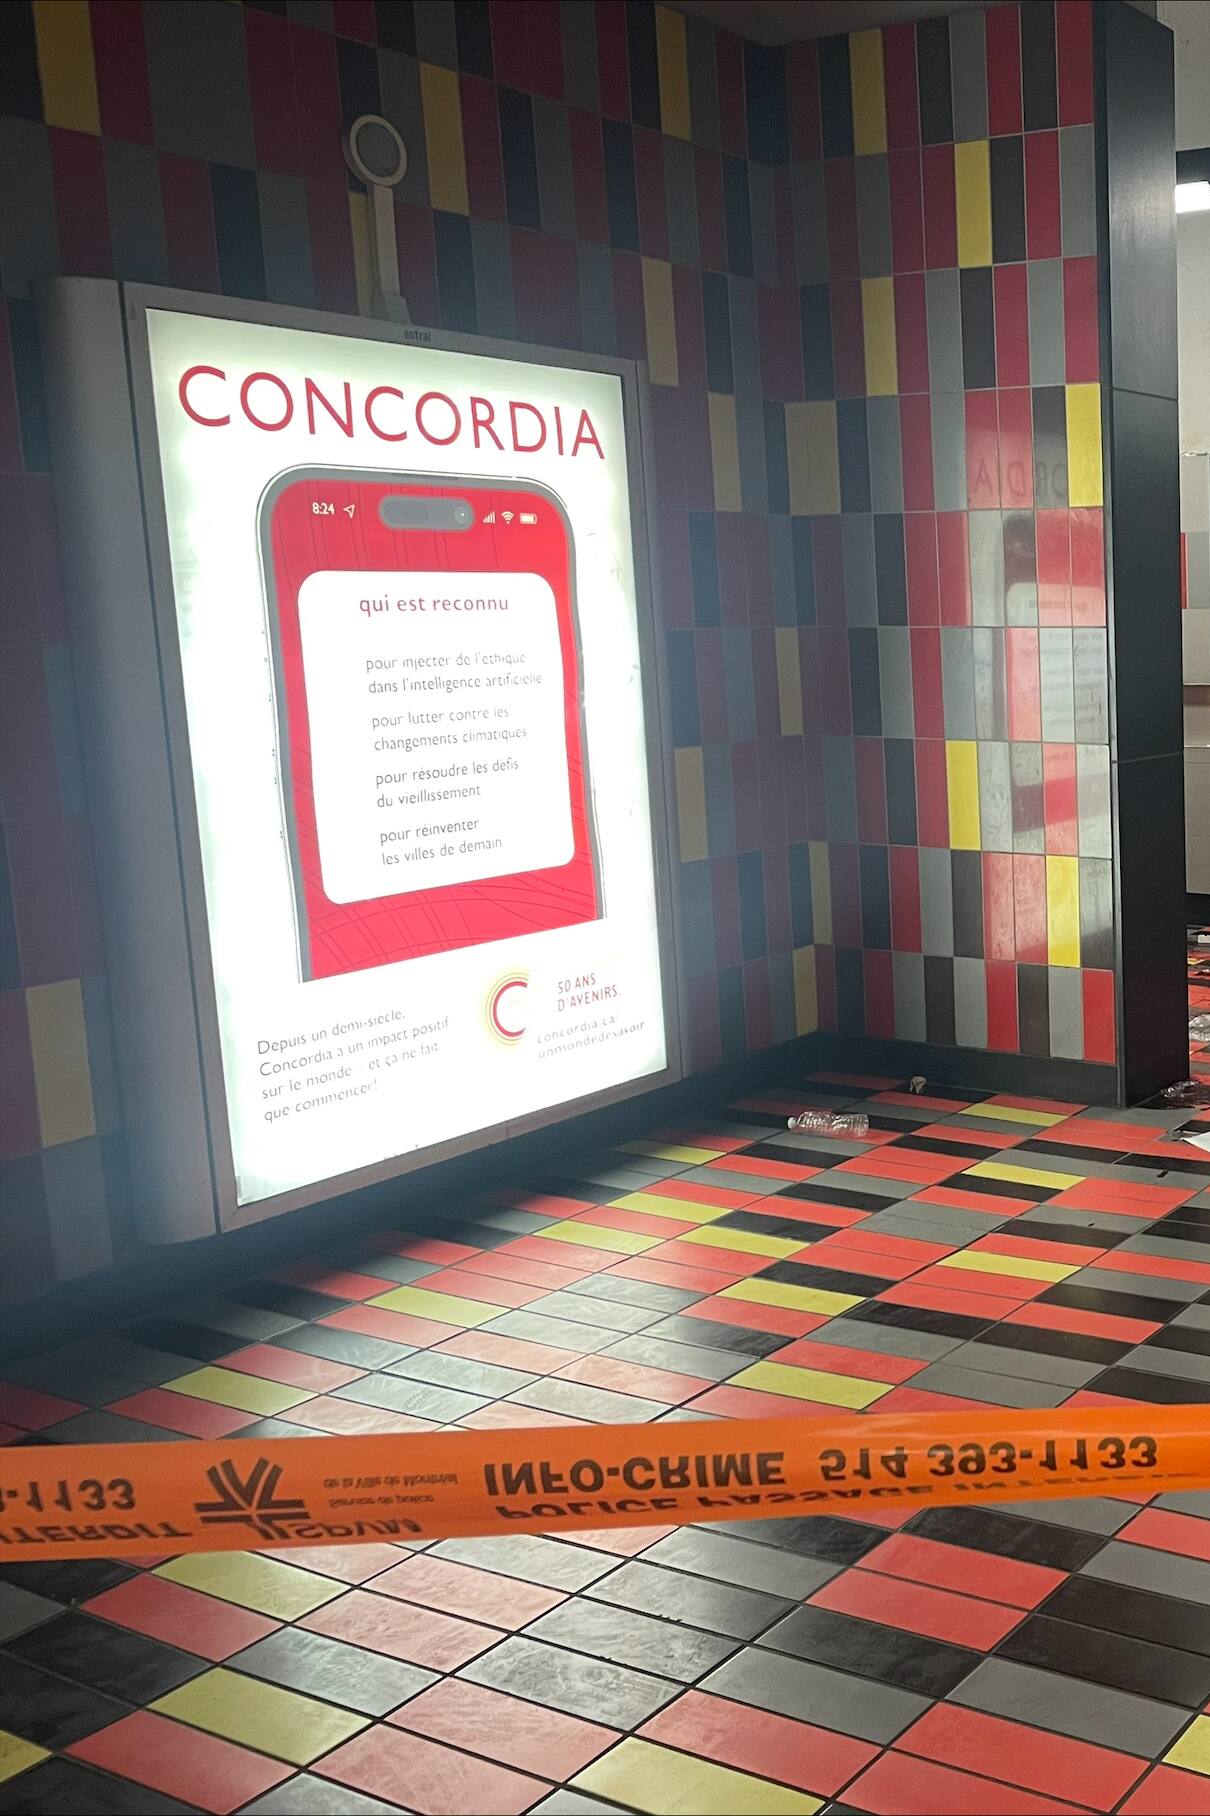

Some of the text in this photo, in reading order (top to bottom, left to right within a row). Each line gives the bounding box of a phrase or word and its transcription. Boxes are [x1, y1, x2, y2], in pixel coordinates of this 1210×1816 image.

[178, 365, 605, 460] CONCORDIA
[312, 501, 335, 516] 8:24
[359, 594, 509, 617] qui est reconnu
[366, 658, 397, 674] pour
[402, 656, 450, 671] injecter
[456, 653, 471, 666] de
[368, 672, 543, 694] dans l'intelligence artificielle
[371, 706, 510, 731] pour lutter contre les
[374, 728, 528, 752] changements climatiques
[375, 772, 407, 789] pour
[412, 763, 468, 781] résoudre
[472, 761, 489, 774] les
[376, 785, 481, 808] du vieillissement
[379, 819, 480, 847] pour réinventer
[381, 838, 503, 866] les villes de demain
[557, 972, 596, 995] 50 ANS
[257, 1034, 307, 1055] Depuis
[311, 1028, 328, 1042] un
[259, 1015, 449, 1076] Concordia a un impact positif
[261, 1042, 439, 1100] sur le monde et ça ne fait
[264, 1105, 291, 1124] que
